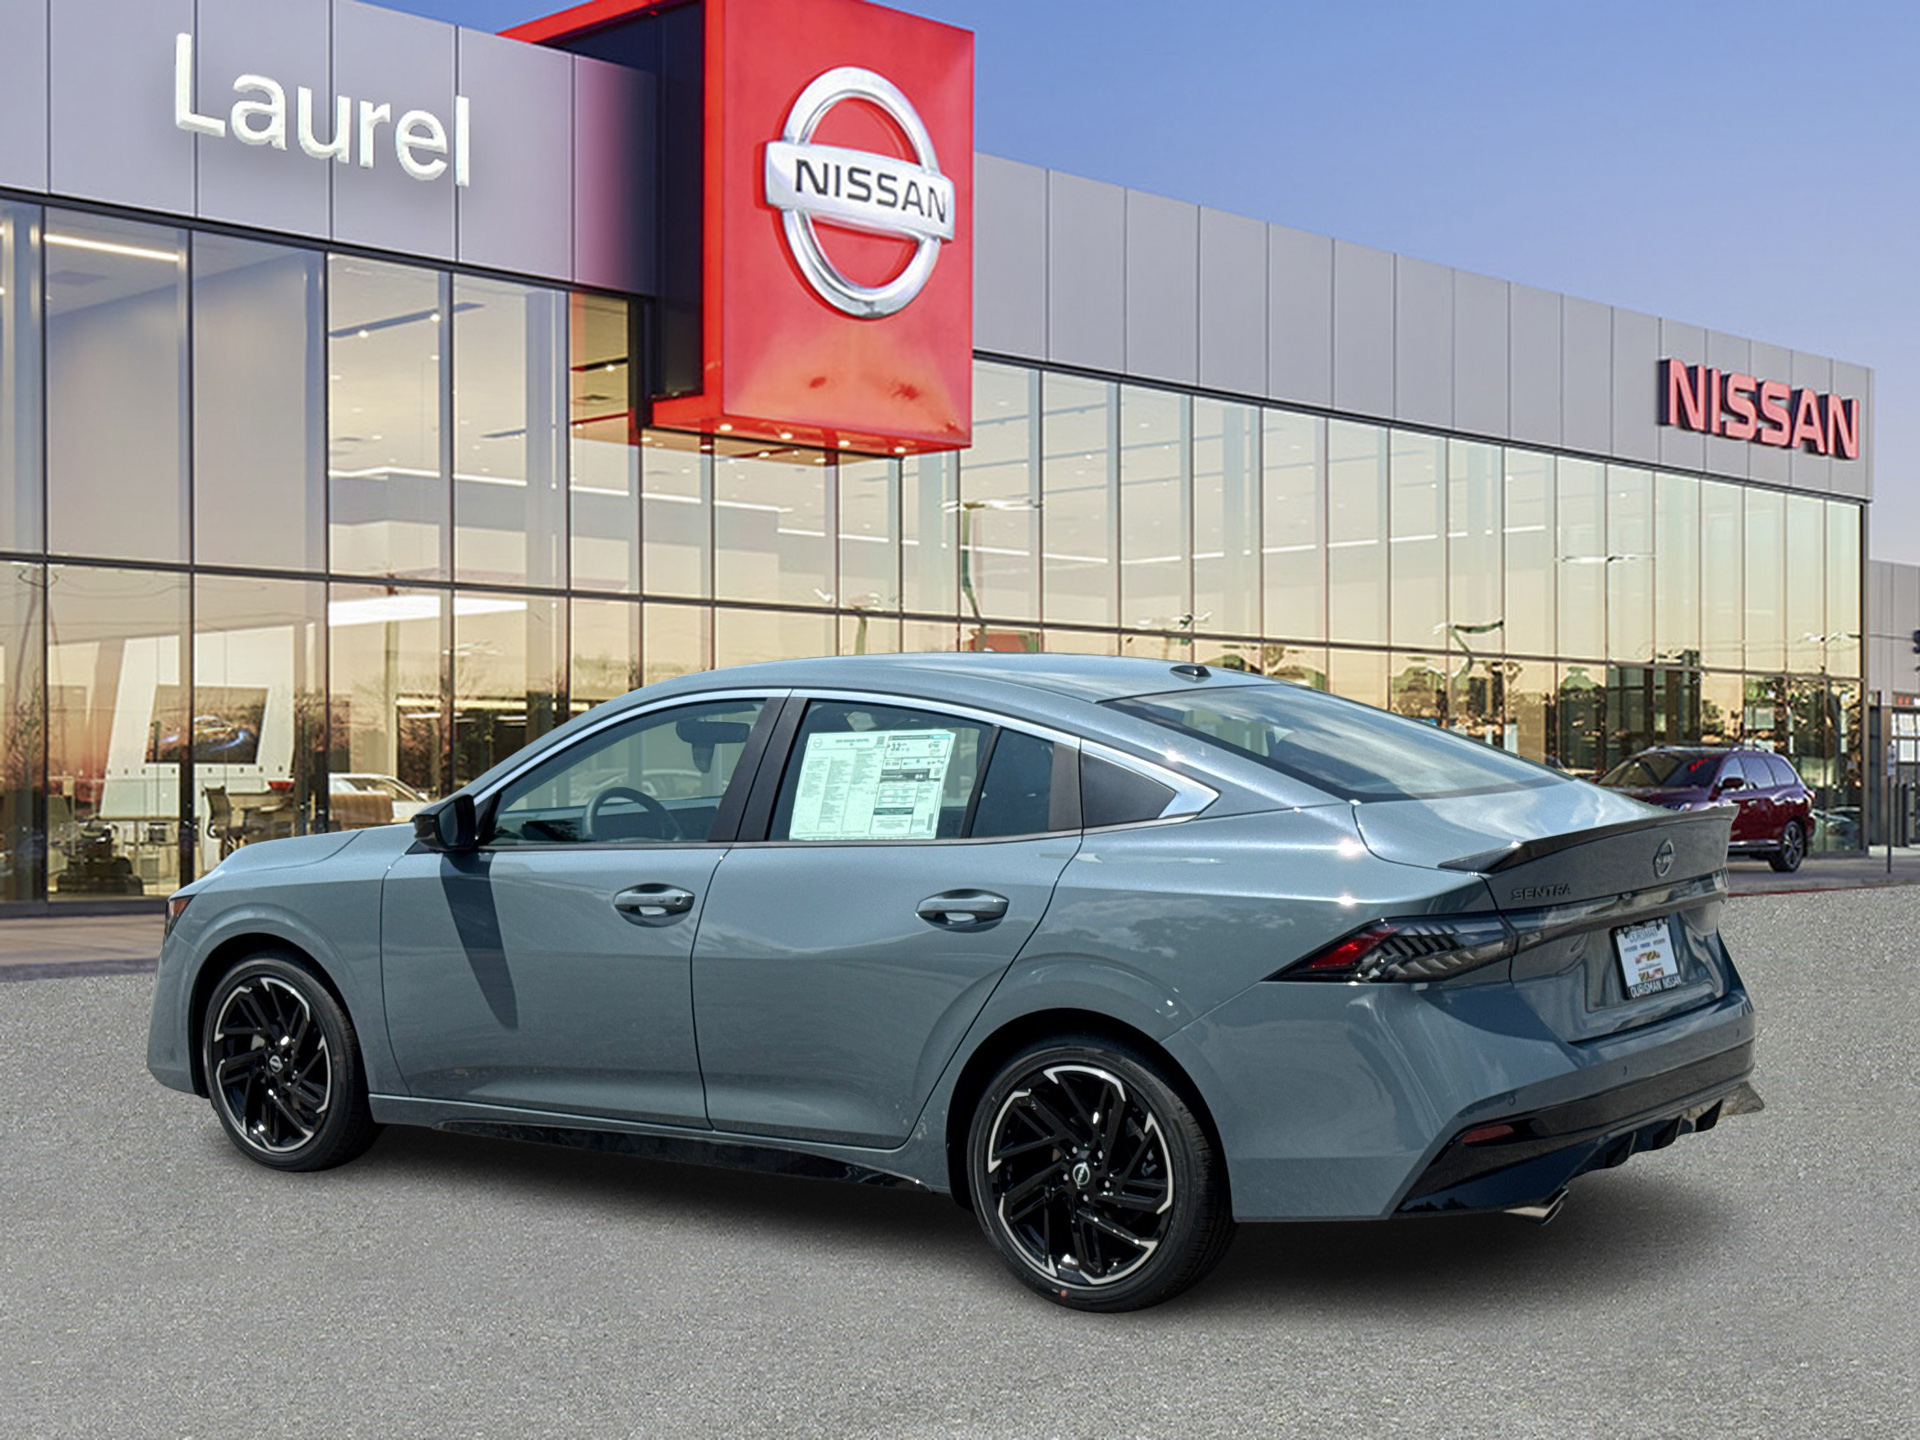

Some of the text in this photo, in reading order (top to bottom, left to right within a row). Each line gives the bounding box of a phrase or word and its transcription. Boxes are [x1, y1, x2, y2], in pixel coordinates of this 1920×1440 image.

[174, 32, 470, 188] Laurel
[794, 157, 947, 224] NISSAN
[1659, 358, 1859, 460] NISSAN
[1510, 883, 1571, 901] SENTRA
[1630, 980, 1662, 998] OURISMAN
